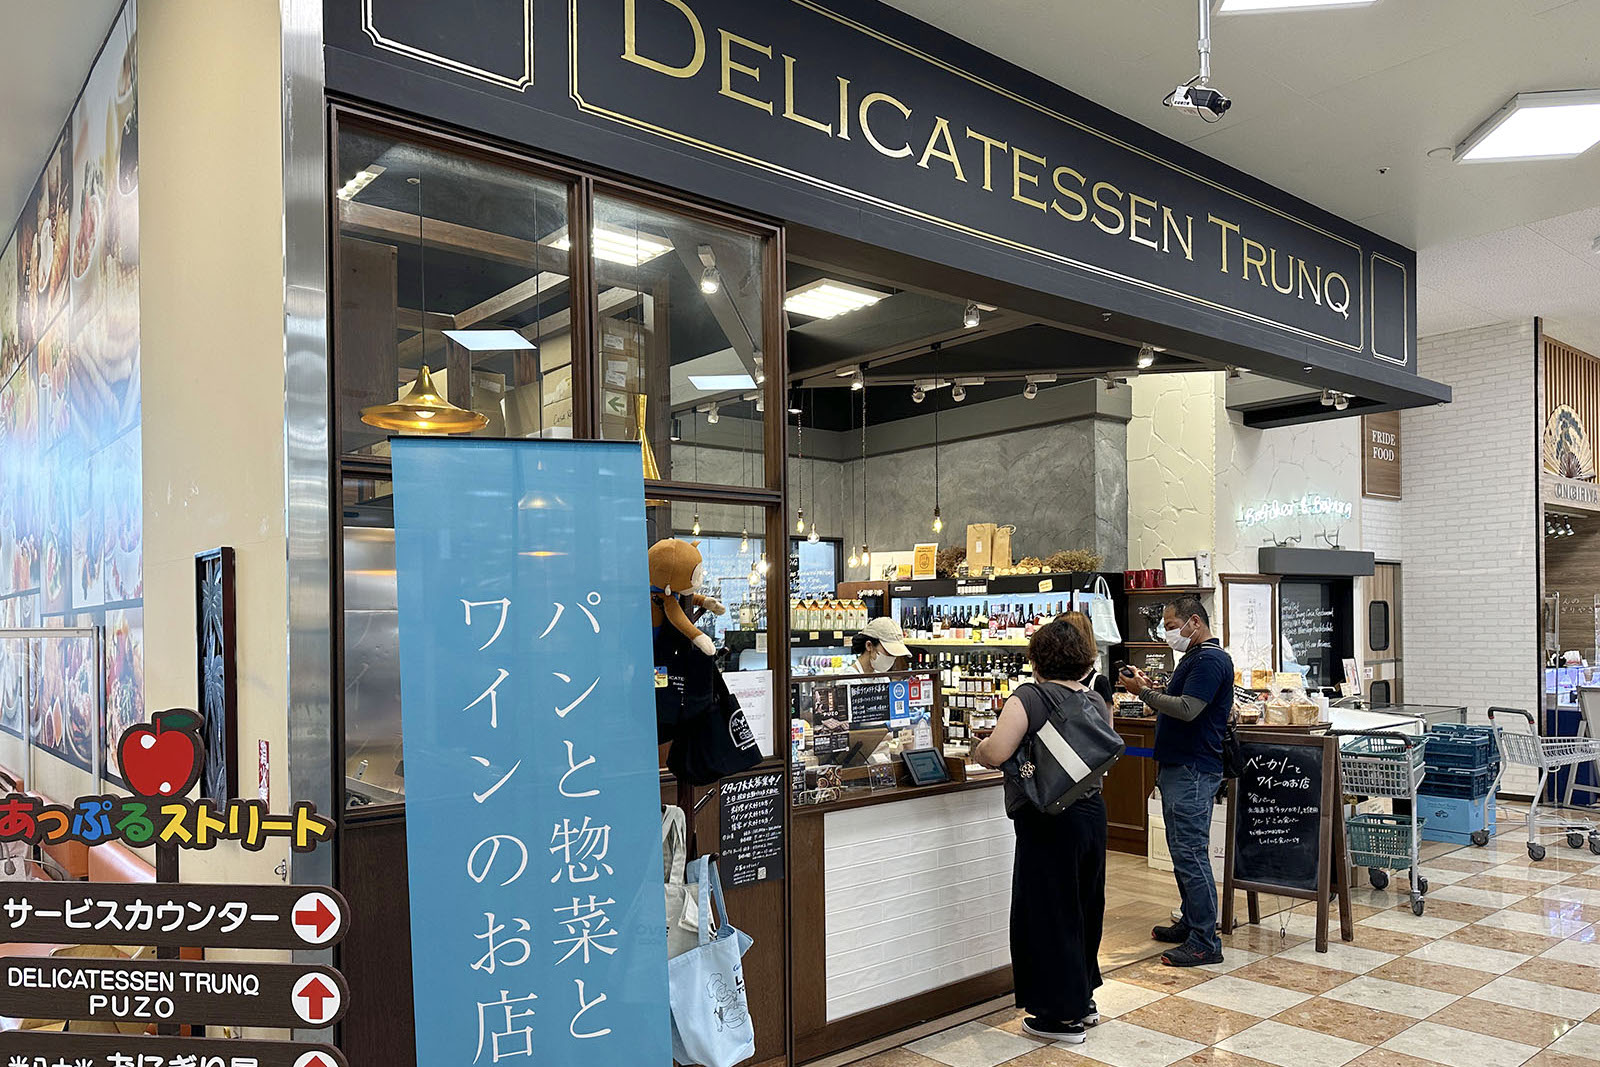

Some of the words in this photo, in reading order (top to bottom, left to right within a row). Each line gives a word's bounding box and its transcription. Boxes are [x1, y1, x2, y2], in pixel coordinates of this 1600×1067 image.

[620, 0, 1195, 262] DELICATESSEN
[1207, 212, 1352, 321] TRUNQ
[1371, 430, 1396, 446] FRIDE
[1373, 446, 1395, 462] FOOD
[1257, 776, 1311, 789] ワインのお店
[0, 801, 327, 847] あっぷるストリート
[459, 597, 538, 1065] ワインのお店
[538, 591, 618, 1039] パンと惣菜と
[3, 897, 280, 933] サービスカウンター
[8, 967, 174, 993] DELICATESSEN
[180, 972, 260, 996] TRUNQ
[89, 995, 175, 1018] PUZO
